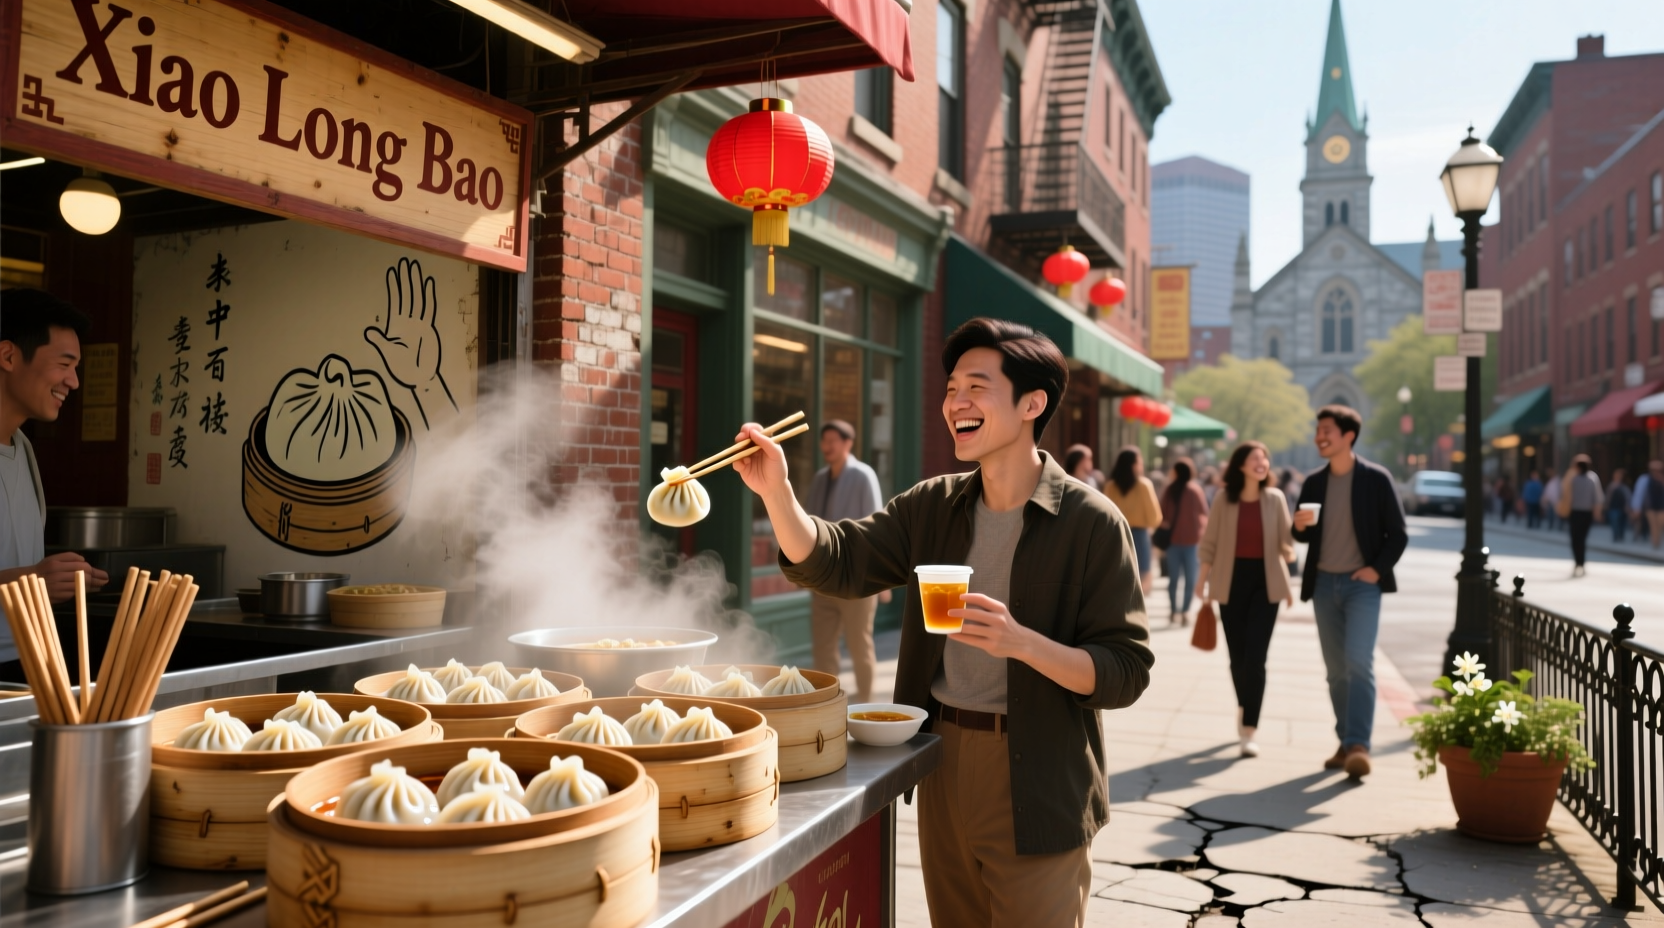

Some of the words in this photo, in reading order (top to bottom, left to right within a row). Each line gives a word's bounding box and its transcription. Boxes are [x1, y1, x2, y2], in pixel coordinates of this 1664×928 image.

[56, 0, 240, 129] Xiao
[258, 64, 407, 201] Long
[417, 121, 504, 211] Bao
